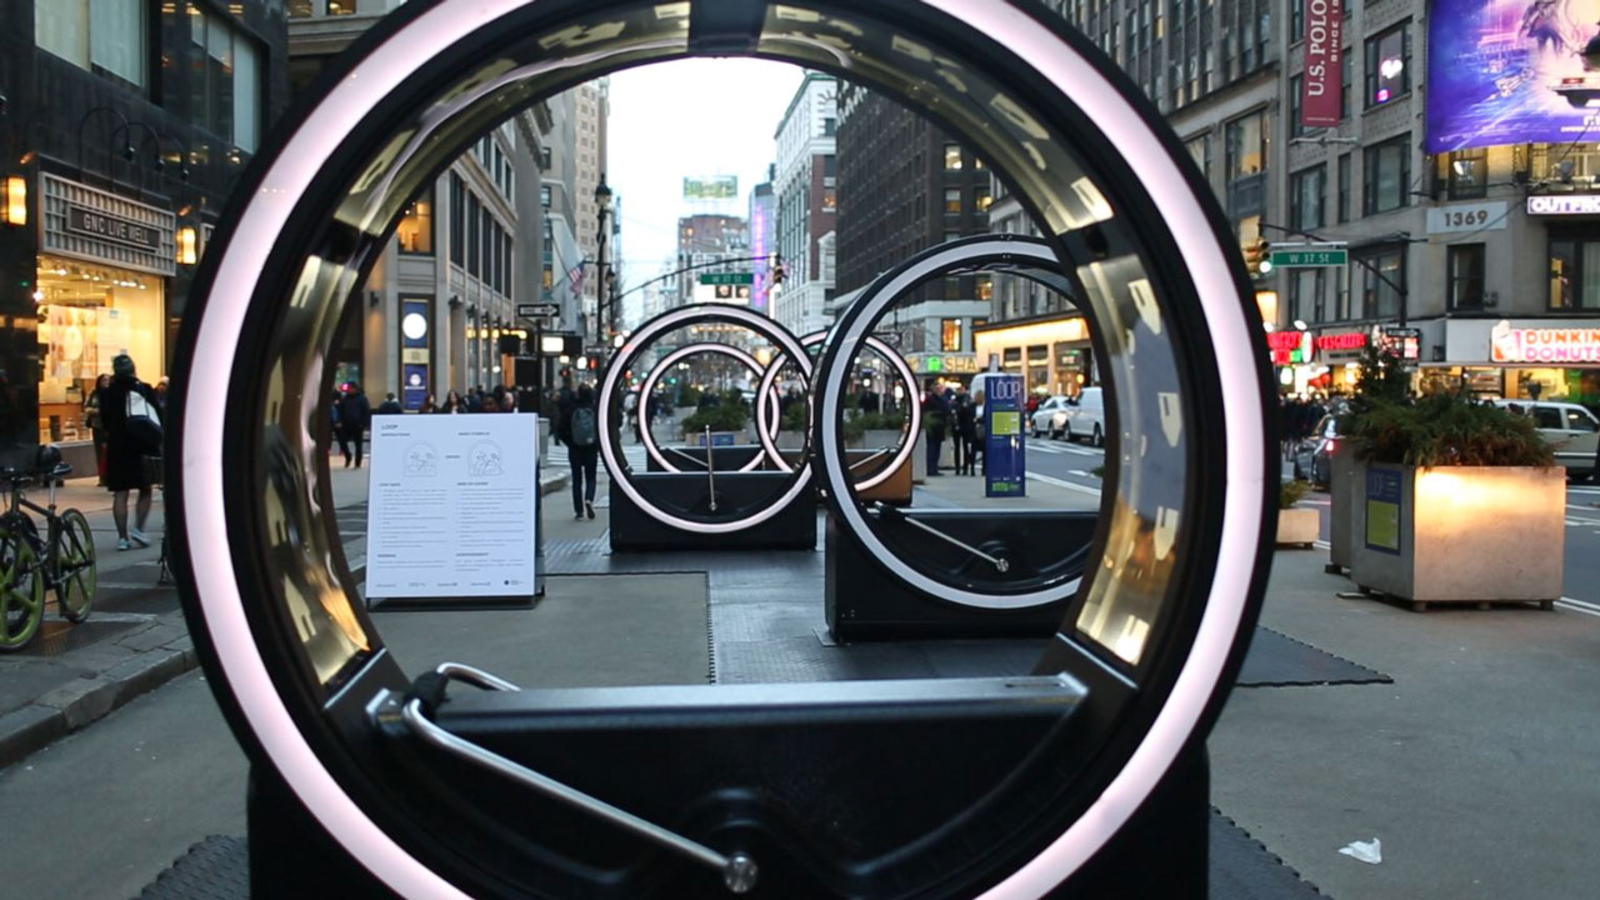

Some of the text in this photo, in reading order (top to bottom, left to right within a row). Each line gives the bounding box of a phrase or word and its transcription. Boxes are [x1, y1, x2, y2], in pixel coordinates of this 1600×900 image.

[1310, 0, 1327, 55] POLO
[1330, 21, 1339, 62] SINCE
[1308, 60, 1325, 96] U.S.
[1444, 210, 1488, 227] 1369
[83, 213, 149, 245] GNC LIVE WELL
[1289, 253, 1299, 263] W
[1303, 253, 1315, 263] 37
[1525, 330, 1600, 345] DUNKIN
[1525, 347, 1600, 361] DONUTS
[990, 380, 1021, 400] LOOP
